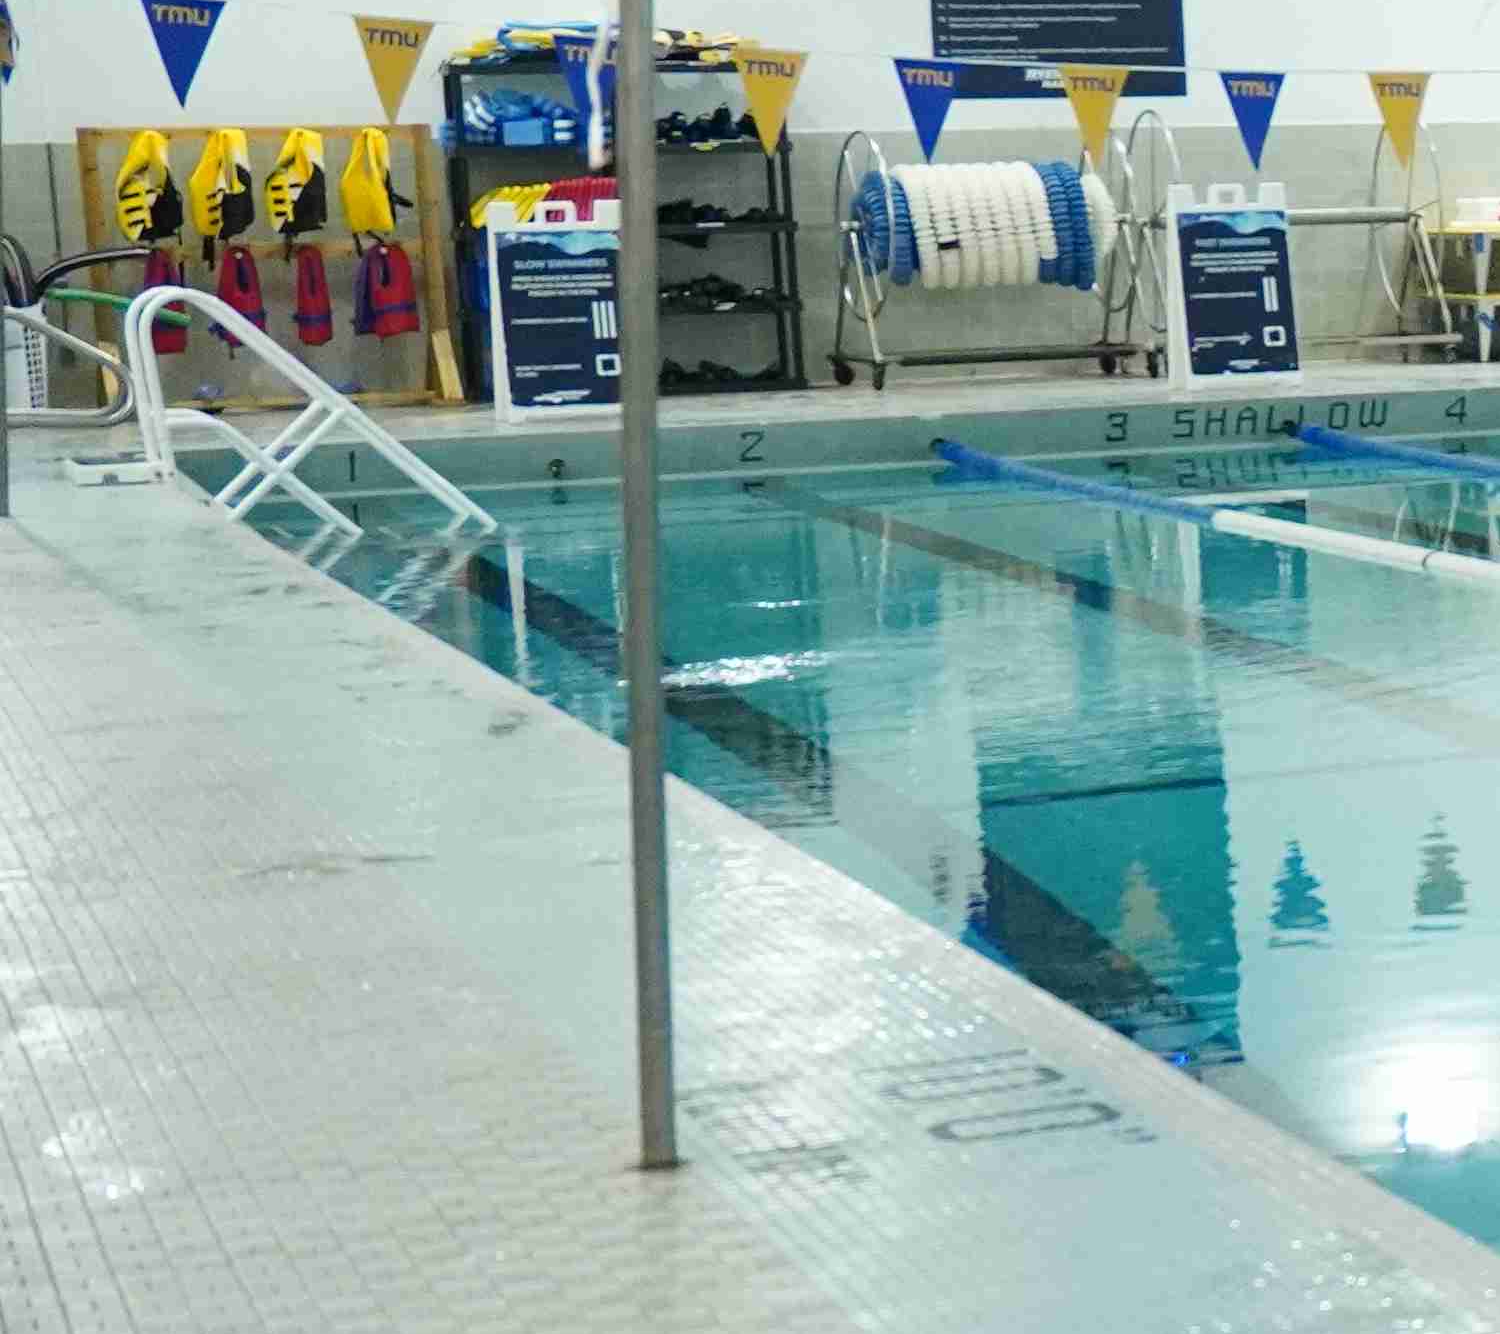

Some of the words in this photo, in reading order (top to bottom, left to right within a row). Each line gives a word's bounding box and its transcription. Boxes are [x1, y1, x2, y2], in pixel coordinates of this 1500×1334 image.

[153, 3, 211, 27] TMU
[365, 26, 419, 48] TMU
[744, 59, 796, 78] TMU
[902, 68, 953, 87] TMU
[1069, 75, 1115, 92] TMU
[1444, 395, 1468, 424] 4
[1105, 411, 1129, 442] 3
[738, 431, 765, 463] 2
